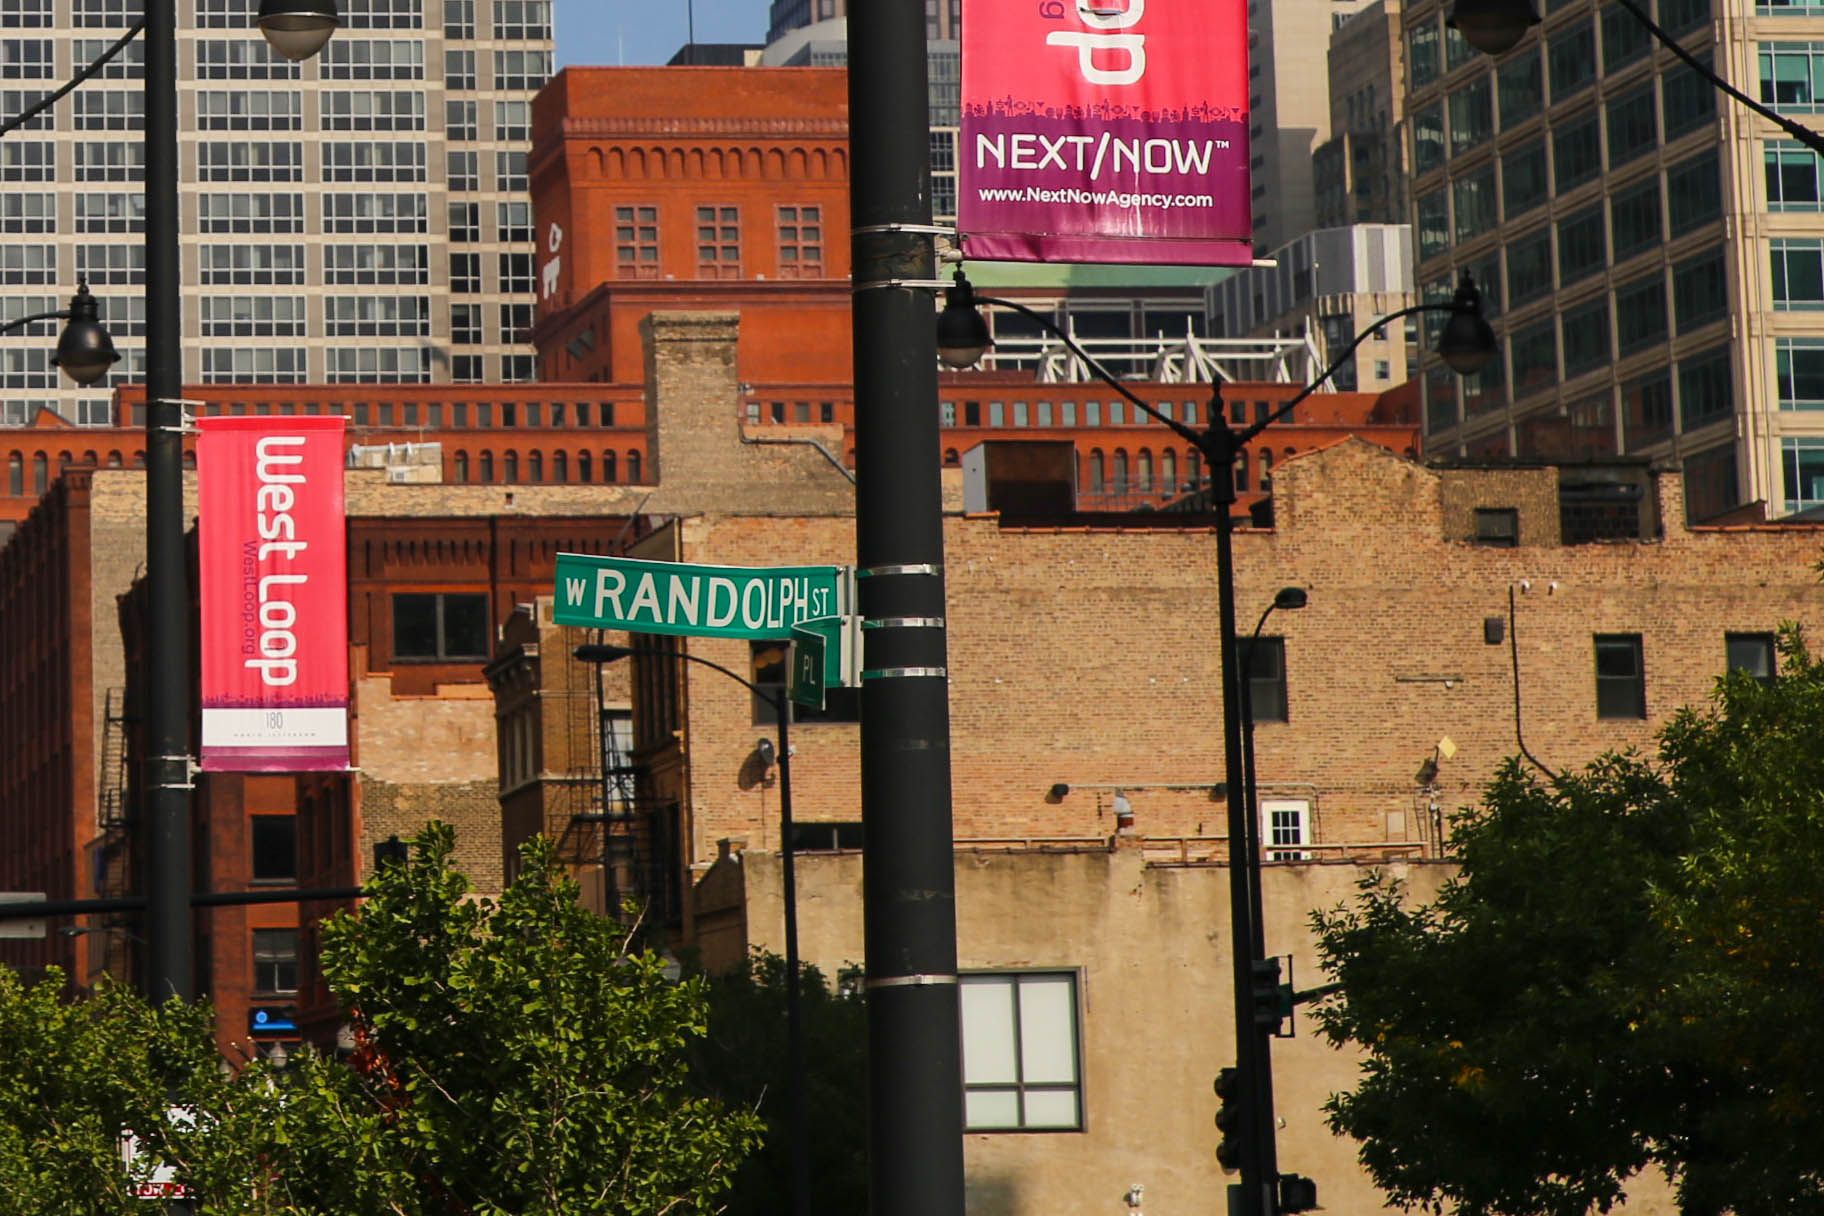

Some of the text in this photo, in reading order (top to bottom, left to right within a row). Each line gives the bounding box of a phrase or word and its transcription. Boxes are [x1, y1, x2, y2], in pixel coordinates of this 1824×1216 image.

[979, 186, 1214, 210] www.NextNowAgency.com
[255, 436, 308, 562] West
[240, 540, 256, 655] WestLoop.org
[244, 575, 309, 686] Loop
[566, 568, 830, 630] W RANDOLPH ST
[266, 711, 283, 730] 180
